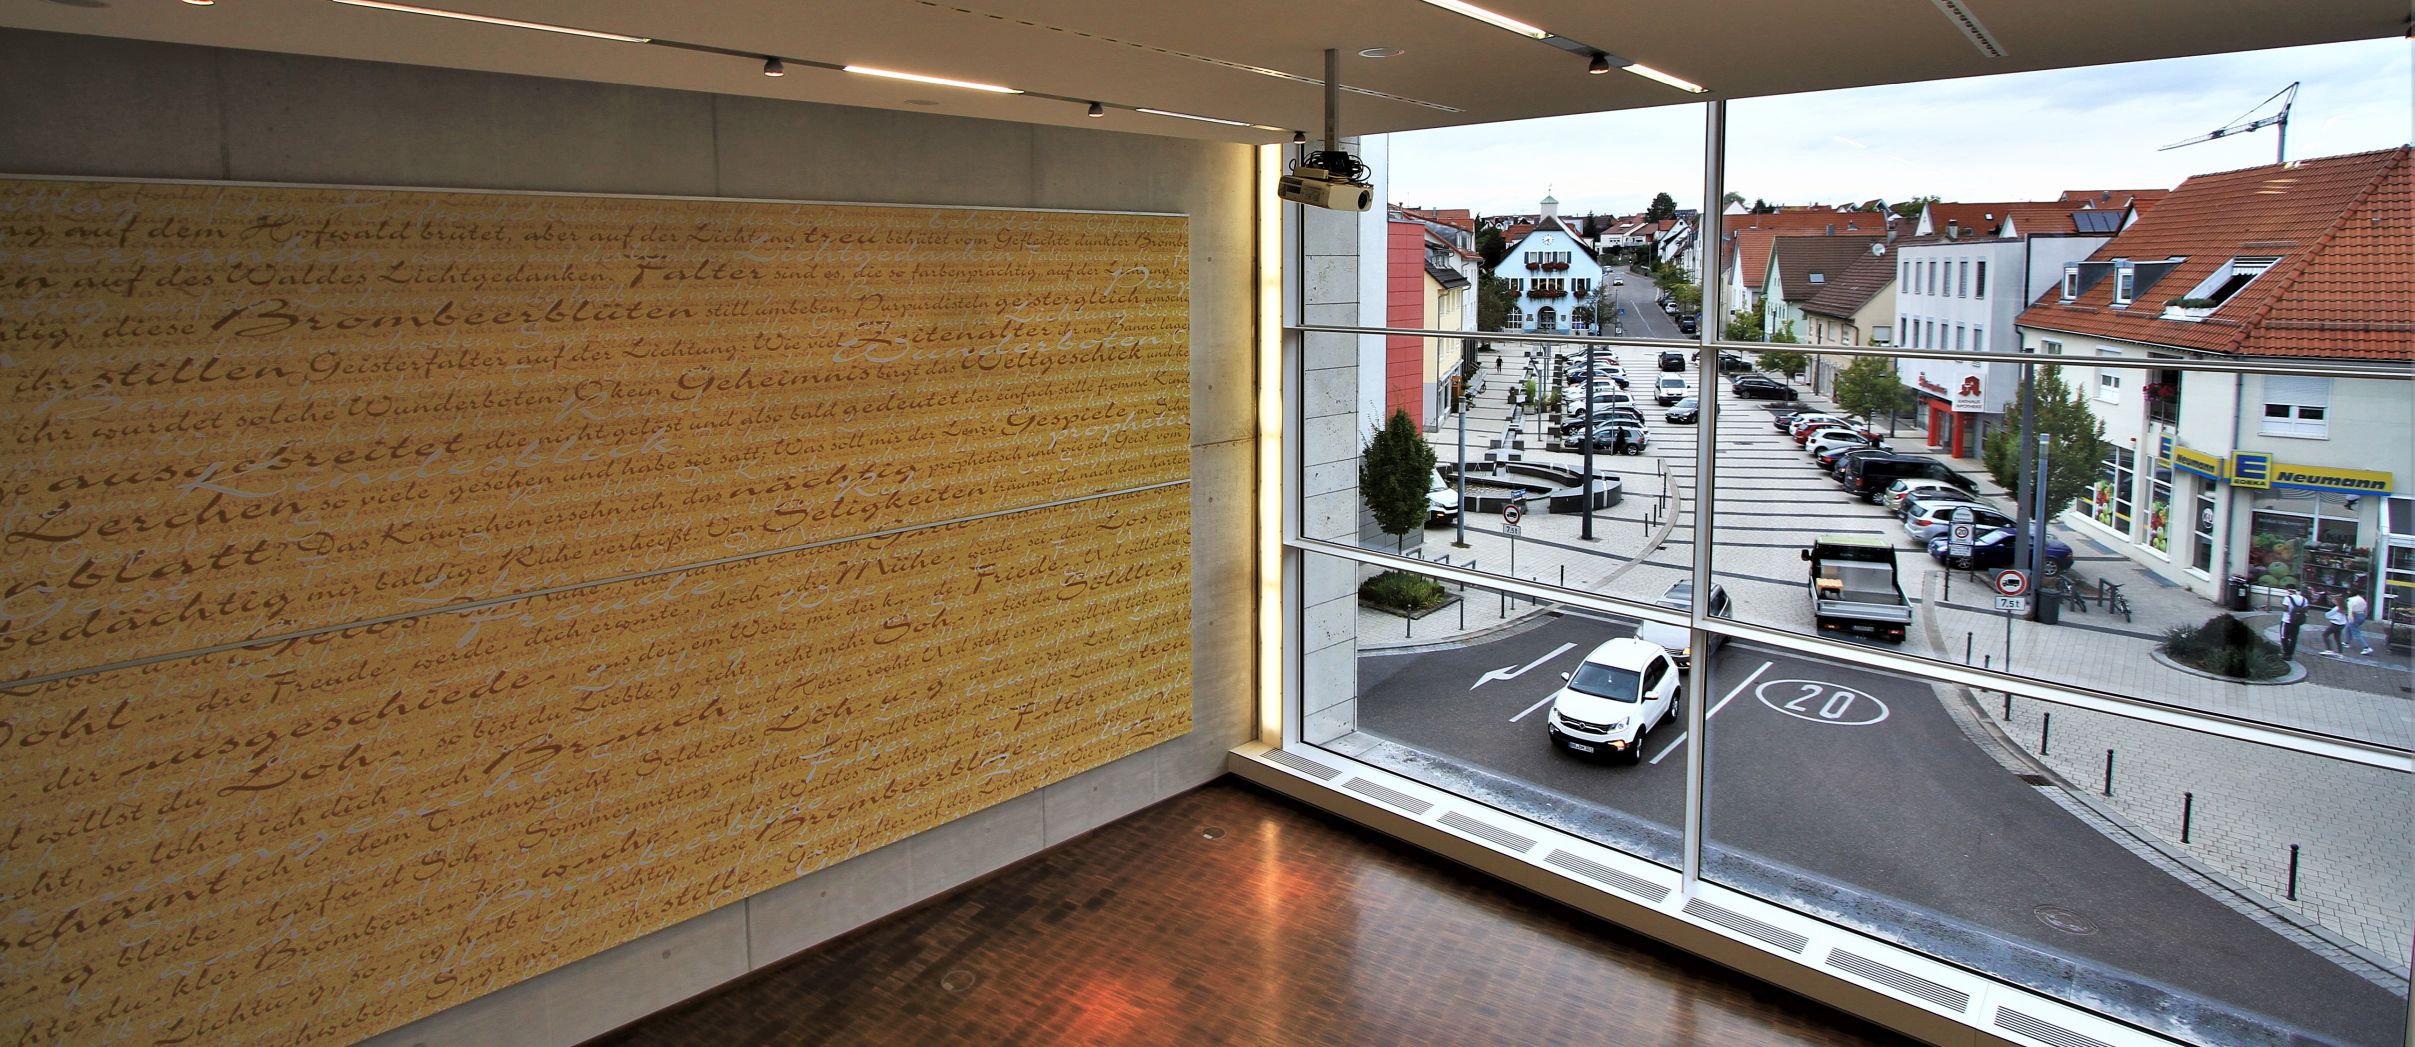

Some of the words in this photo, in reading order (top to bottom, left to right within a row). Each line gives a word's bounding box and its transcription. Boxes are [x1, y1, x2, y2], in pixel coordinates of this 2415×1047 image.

[64, 211, 142, 248] auf
[147, 216, 229, 240] dem
[523, 222, 578, 243] aber
[589, 225, 634, 251] auf
[639, 224, 679, 243] der
[687, 221, 797, 246] Lichtung
[804, 226, 881, 246] treu
[72, 264, 144, 297] auf
[155, 263, 214, 287] des
[227, 262, 368, 287] Waldes
[623, 254, 767, 289] Falter
[773, 263, 818, 282] sind
[853, 264, 882, 280] die
[888, 269, 905, 279] so
[102, 314, 197, 338] diese
[705, 300, 749, 318] still
[853, 293, 990, 317] Purpurdisteln
[995, 286, 1139, 316] geistergleich
[15, 367, 77, 393] ihr
[92, 356, 301, 388] stillen
[304, 347, 507, 382] Geisterfalter
[516, 340, 567, 371] auf
[571, 336, 616, 362] der
[754, 331, 802, 350] Wie
[16, 411, 78, 446] ihr
[92, 409, 223, 441] wurdet
[235, 396, 336, 428] solche
[671, 364, 872, 402] Geheimnis
[925, 361, 957, 376] das
[690, 407, 734, 431] und
[842, 393, 960, 420] gedeutet
[5, 493, 309, 544] Lerchen
[320, 498, 348, 511] so
[449, 467, 559, 505] gesehen
[562, 458, 615, 483] und
[622, 452, 678, 477] habe
[1000, 402, 1129, 436] Gespiele
[2175, 453, 2216, 474] Neumann
[2233, 478, 2267, 486] EDEKA
[2235, 454, 2267, 480] E
[2277, 471, 2387, 491] Neumann
[297, 531, 370, 556] Das
[929, 446, 1022, 478] prophetisch
[1784, 684, 1856, 720] 20
